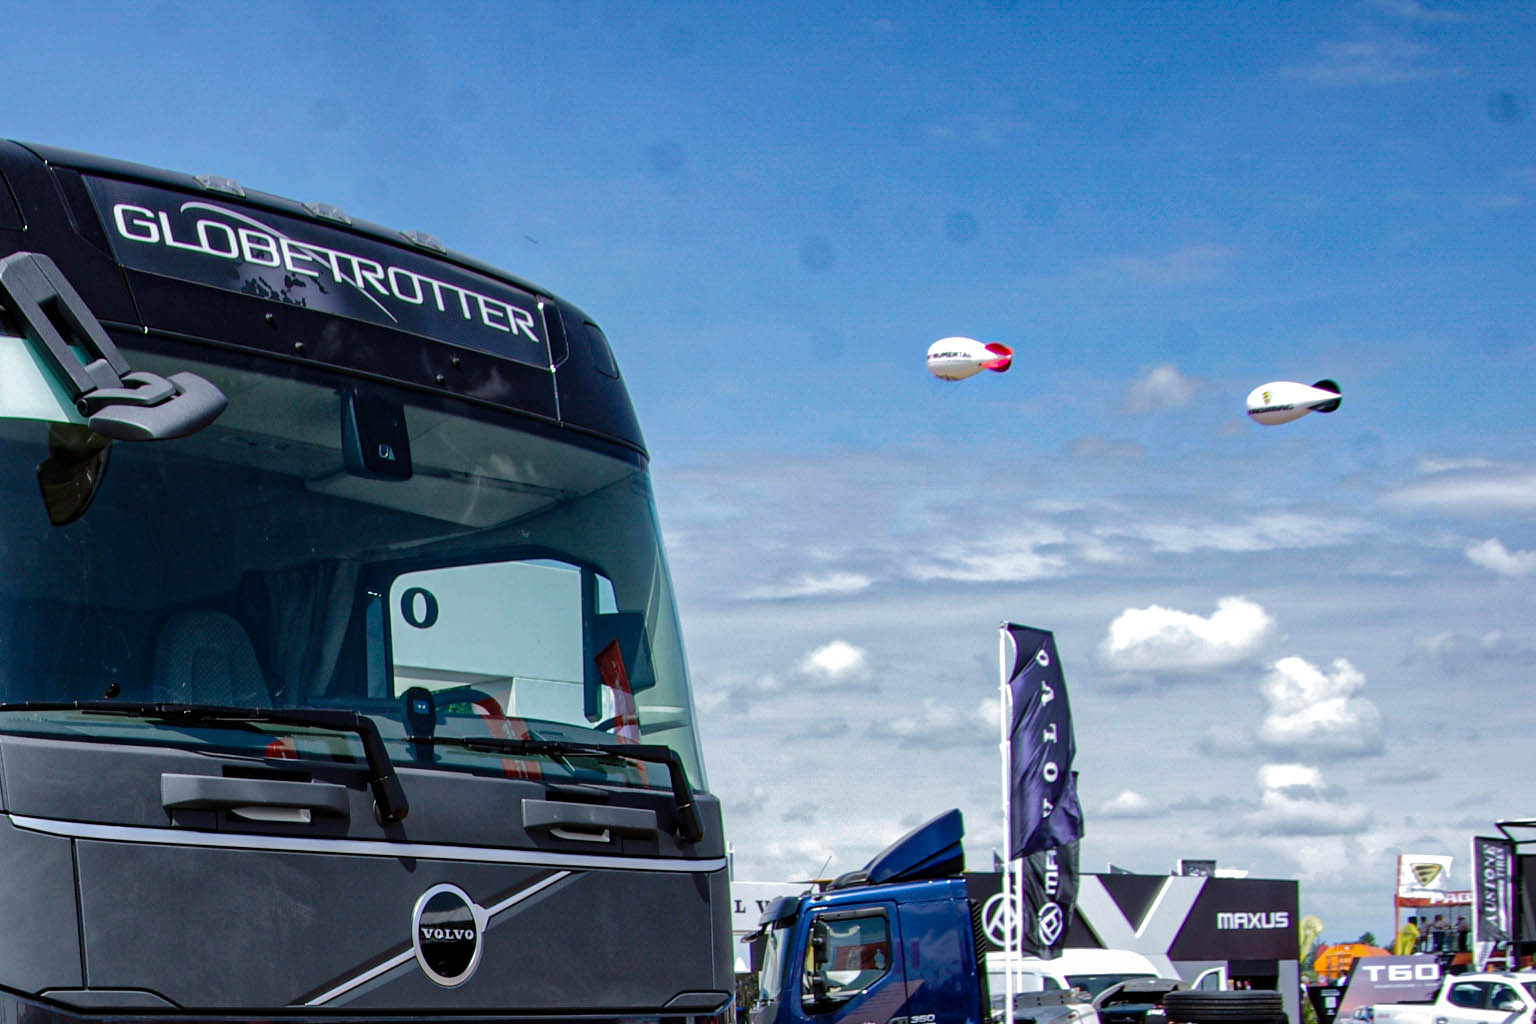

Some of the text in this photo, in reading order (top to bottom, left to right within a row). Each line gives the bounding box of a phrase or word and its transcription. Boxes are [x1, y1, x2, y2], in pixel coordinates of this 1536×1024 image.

[113, 202, 540, 343] GLOBETROTTER
[1217, 912, 1289, 929] MAXUS
[421, 927, 475, 941] VOLVO
[1362, 963, 1439, 981] T60
[911, 1014, 936, 1024] 350
